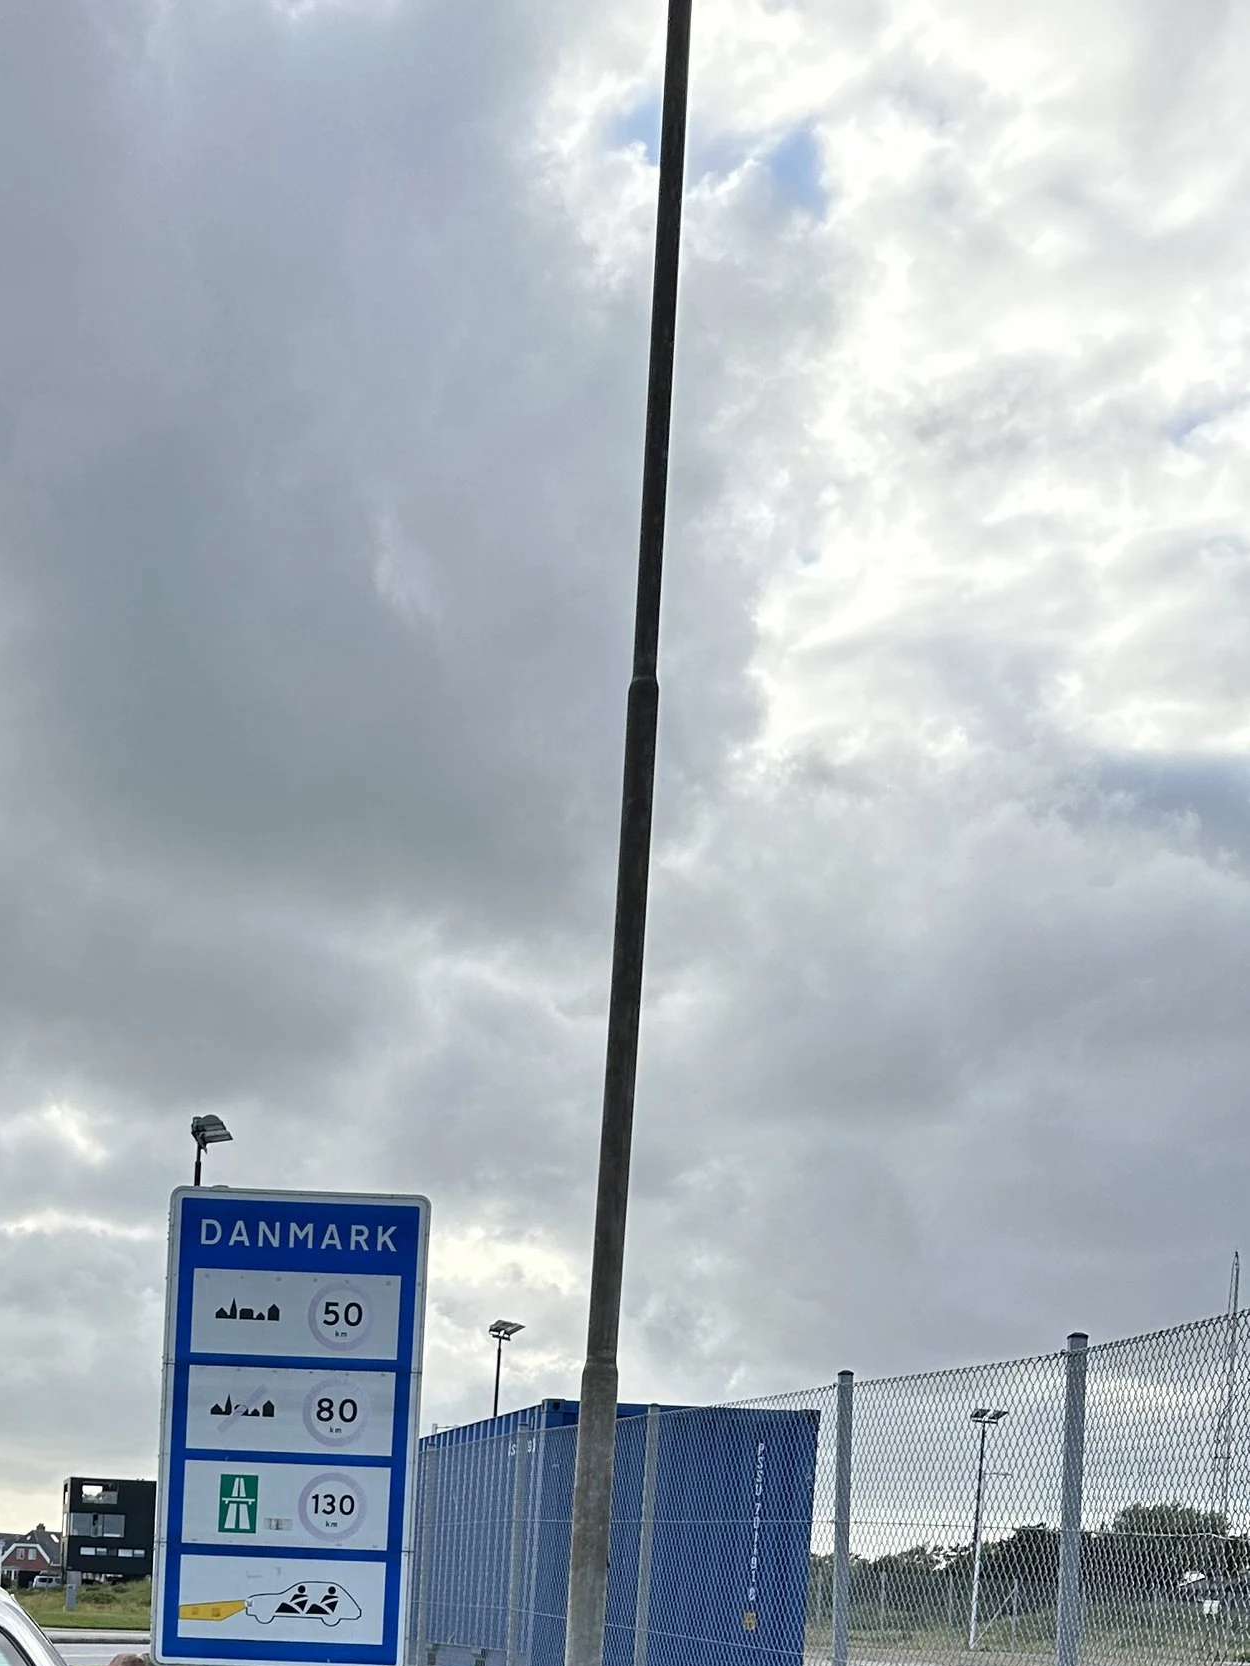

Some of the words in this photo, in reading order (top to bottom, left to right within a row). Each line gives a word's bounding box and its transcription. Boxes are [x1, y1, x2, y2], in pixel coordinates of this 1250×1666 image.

[200, 1218, 398, 1252] DANMARK
[322, 1301, 363, 1327] 50
[335, 1330, 348, 1338] km
[316, 1397, 358, 1423] 80
[329, 1426, 342, 1434] km
[755, 1443, 765, 1496] PSSU
[312, 1493, 355, 1516] 130
